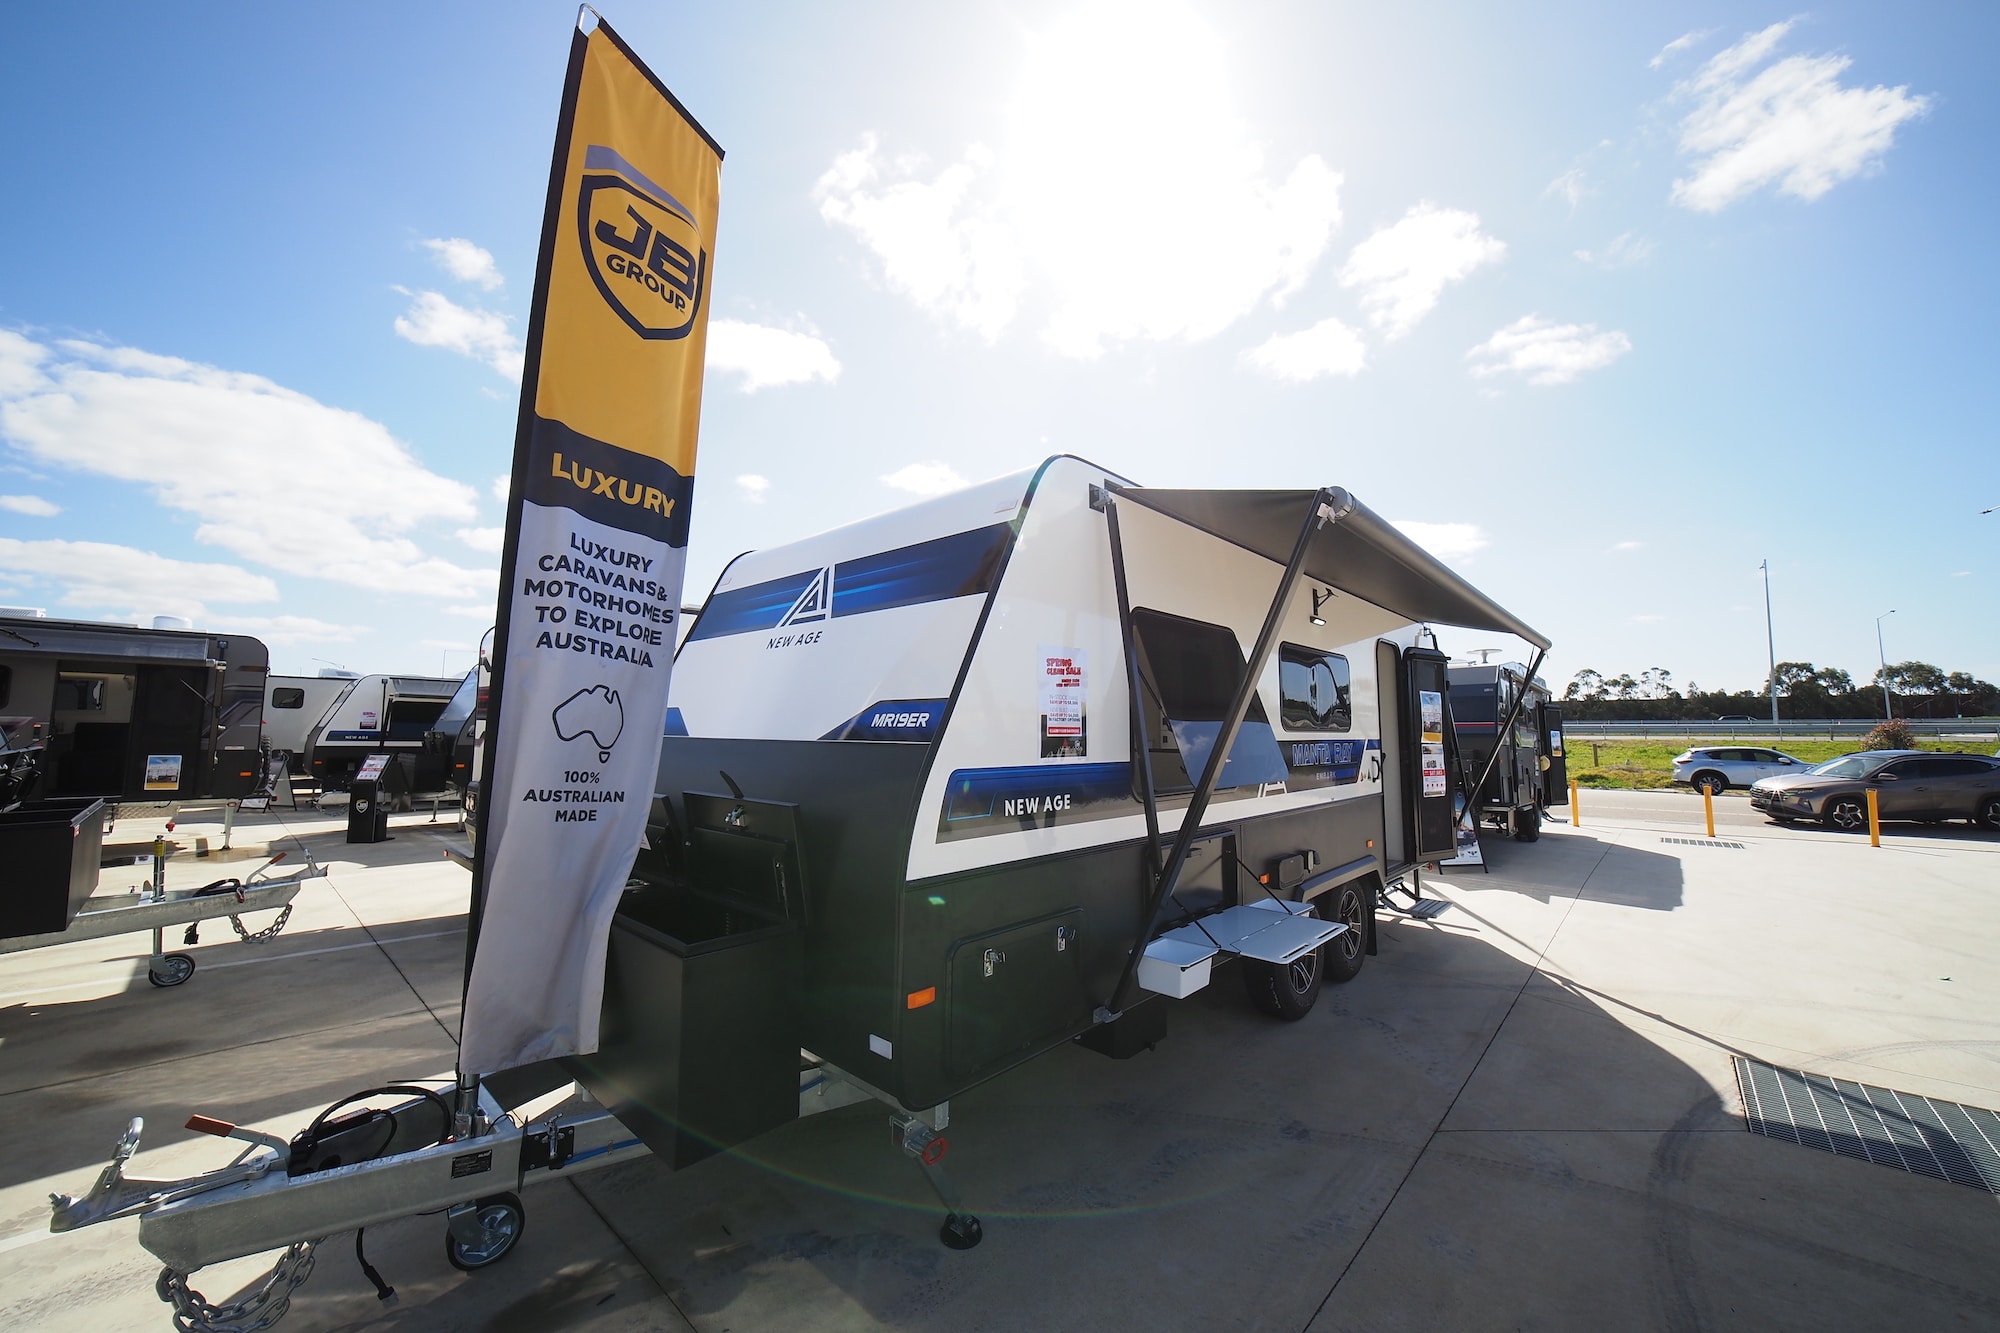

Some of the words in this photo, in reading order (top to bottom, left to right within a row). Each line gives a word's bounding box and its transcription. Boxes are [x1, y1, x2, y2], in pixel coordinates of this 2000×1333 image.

[595, 204, 697, 301] JB
[606, 254, 686, 310] GROUP
[551, 452, 676, 519] LUXURY
[570, 532, 653, 573] LUXURY
[523, 578, 674, 624] MOTORHOMES
[535, 606, 567, 623] TO
[574, 612, 662, 646] EXPLORE
[766, 635, 796, 650] NEW
[794, 631, 823, 646] AGE
[536, 631, 653, 668] AUSTRALIA
[870, 712, 930, 728] MR19ER
[1292, 743, 1332, 766] MANTA
[1334, 742, 1354, 763] RAY
[563, 770, 600, 784] 100%
[523, 789, 625, 803] AUSTRALIAN
[1004, 797, 1039, 817] NEW
[1043, 794, 1071, 812] AGE
[555, 810, 597, 823] MADE
